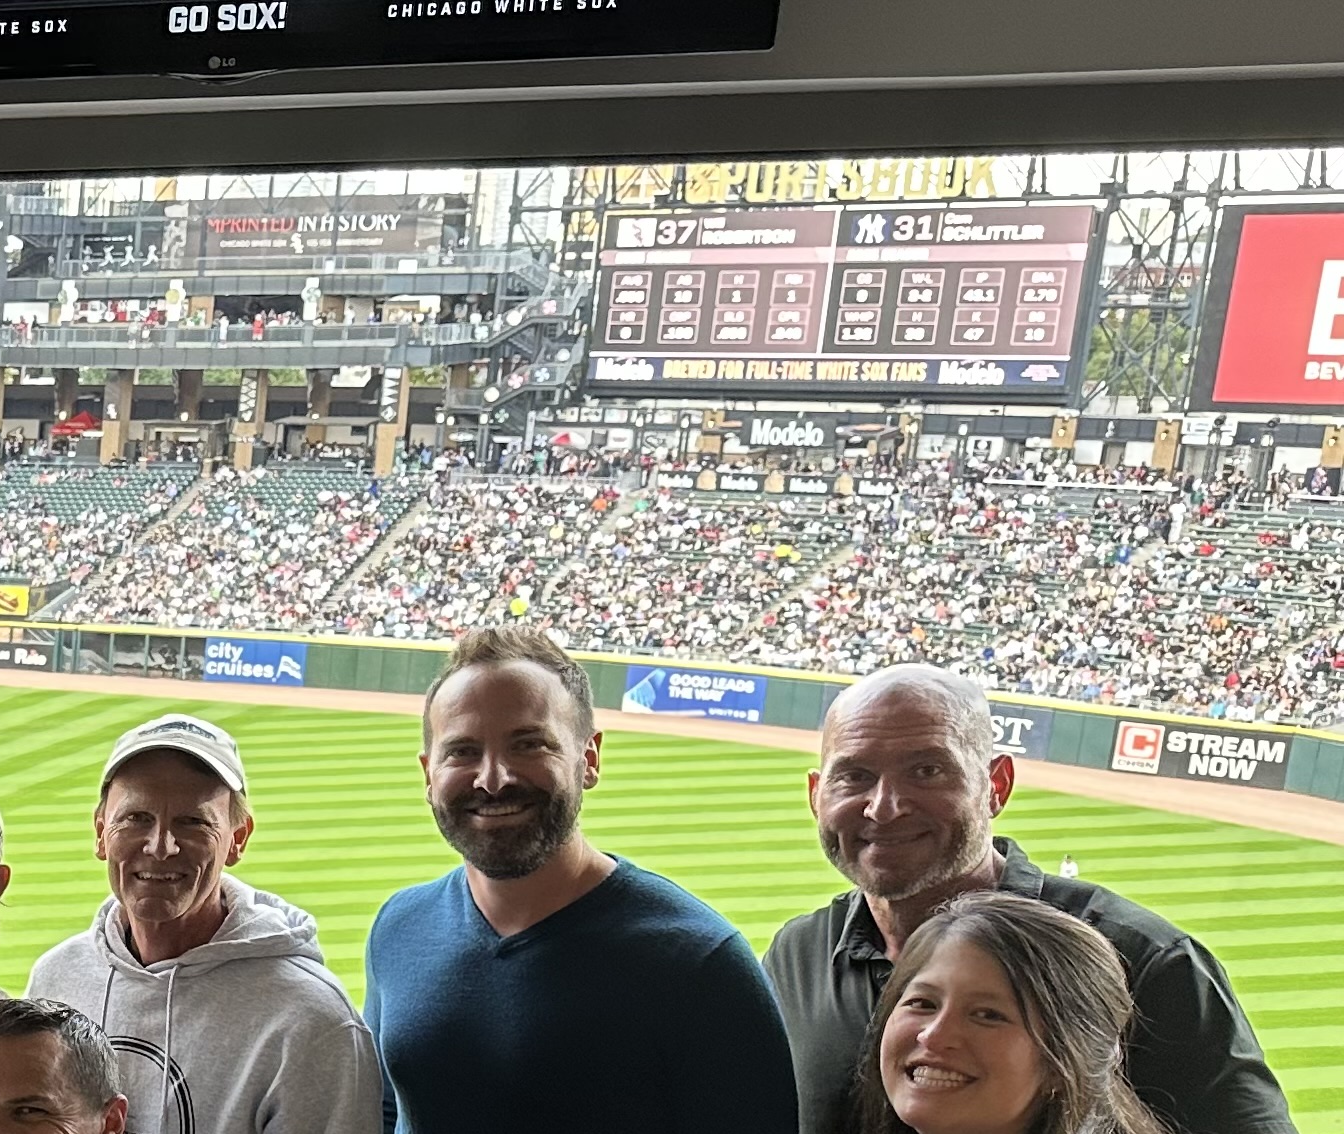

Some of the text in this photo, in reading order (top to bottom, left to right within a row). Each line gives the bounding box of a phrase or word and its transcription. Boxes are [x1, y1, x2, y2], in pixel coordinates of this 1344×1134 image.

[168, 1, 287, 33] GO SOX!
[387, 0, 482, 18] CHICAGO
[494, 0, 562, 13] WHITE
[31, 19, 68, 34] SOX
[222, 57, 236, 67] LG
[320, 214, 401, 232] HSTORY
[657, 219, 698, 245] 37
[892, 215, 934, 241] 31
[663, 359, 716, 379] BREWED
[717, 360, 745, 379] FOR
[746, 360, 814, 380] FULL-TIME
[816, 361, 860, 381] WHITE
[861, 361, 889, 381] SOX
[890, 362, 928, 382] FANS
[938, 360, 1005, 385] Modelo
[750, 418, 824, 447] Modelo
[720, 474, 758, 491] Modelo
[207, 641, 243, 662] city
[206, 659, 273, 678] cruises
[668, 673, 755, 693] GOOD LEADS
[668, 685, 724, 703] THE WAY
[1167, 730, 1286, 763] STREAM
[1187, 753, 1257, 781] NOW
